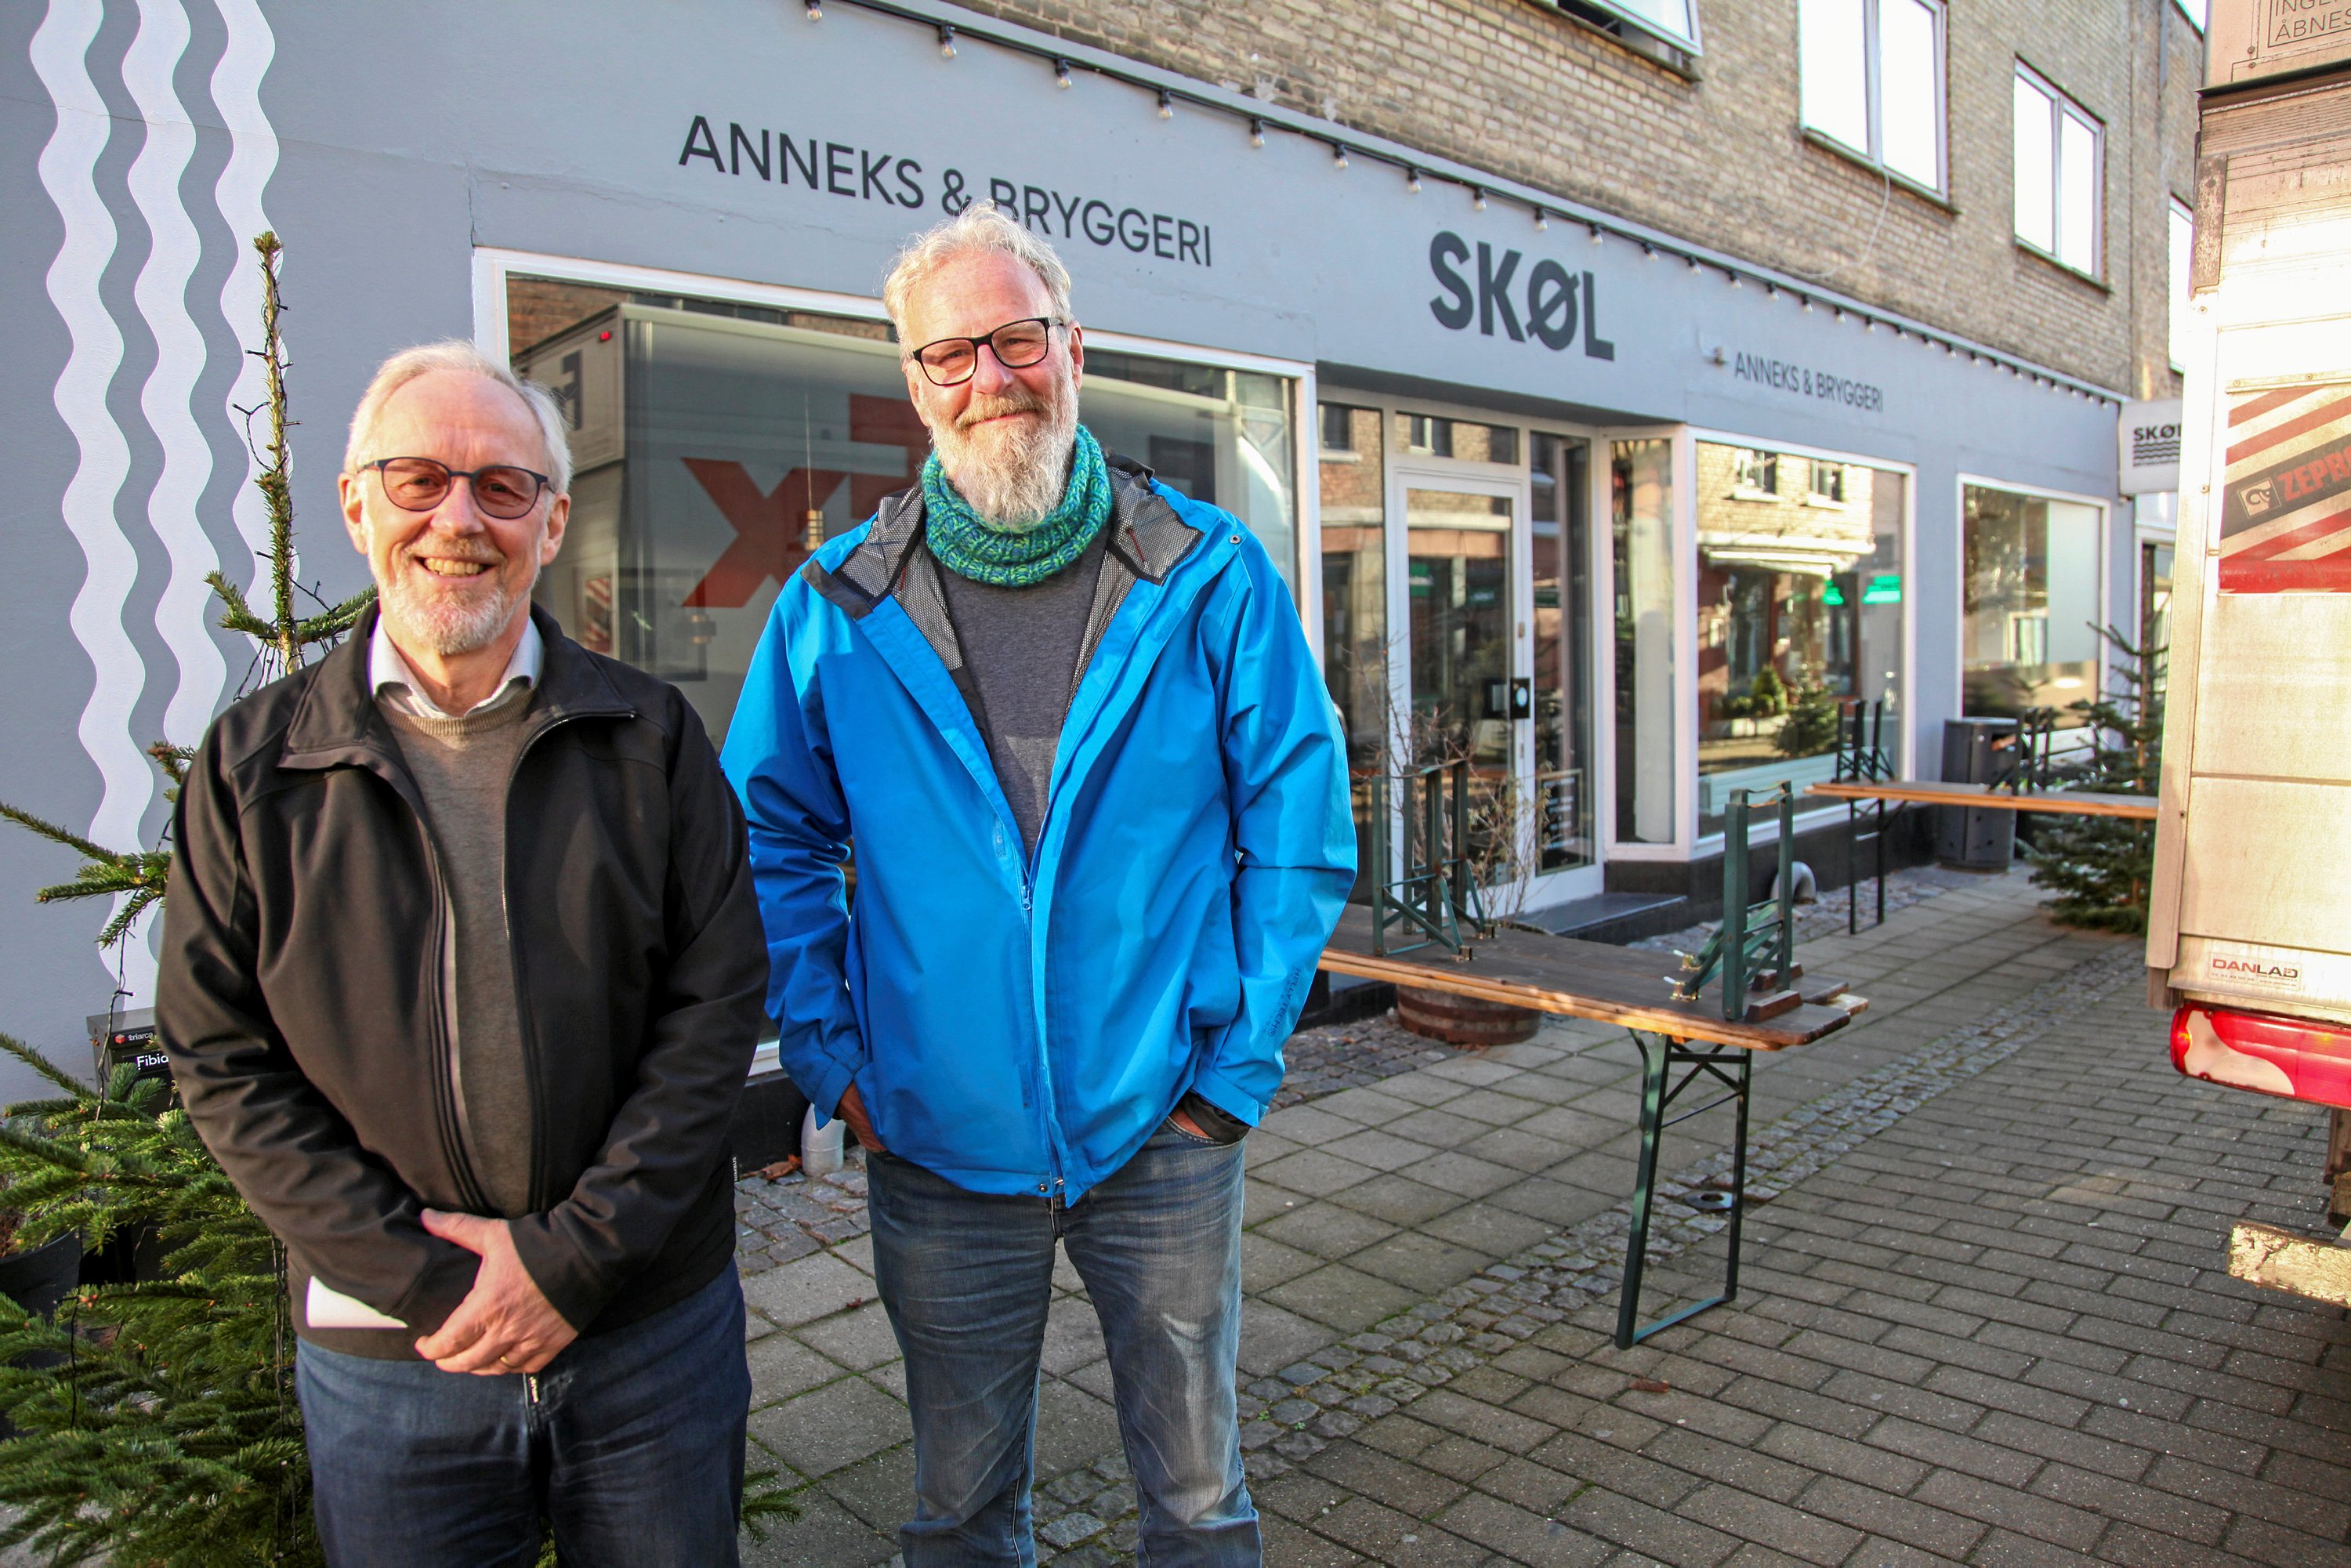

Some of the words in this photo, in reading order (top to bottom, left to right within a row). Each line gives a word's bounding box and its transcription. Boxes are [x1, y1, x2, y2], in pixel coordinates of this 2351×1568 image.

[679, 115, 924, 209] ANNEKS
[941, 168, 972, 217] &
[990, 176, 1212, 267] BRYGGERI
[1429, 230, 1615, 362] SKØL
[1734, 351, 1800, 393] ANNEKS
[1803, 368, 1814, 396] &
[1816, 371, 1884, 414] BRYGGERI
[1285, 965, 1302, 1000] HELLY
[2212, 958, 2298, 979] DANLAD
